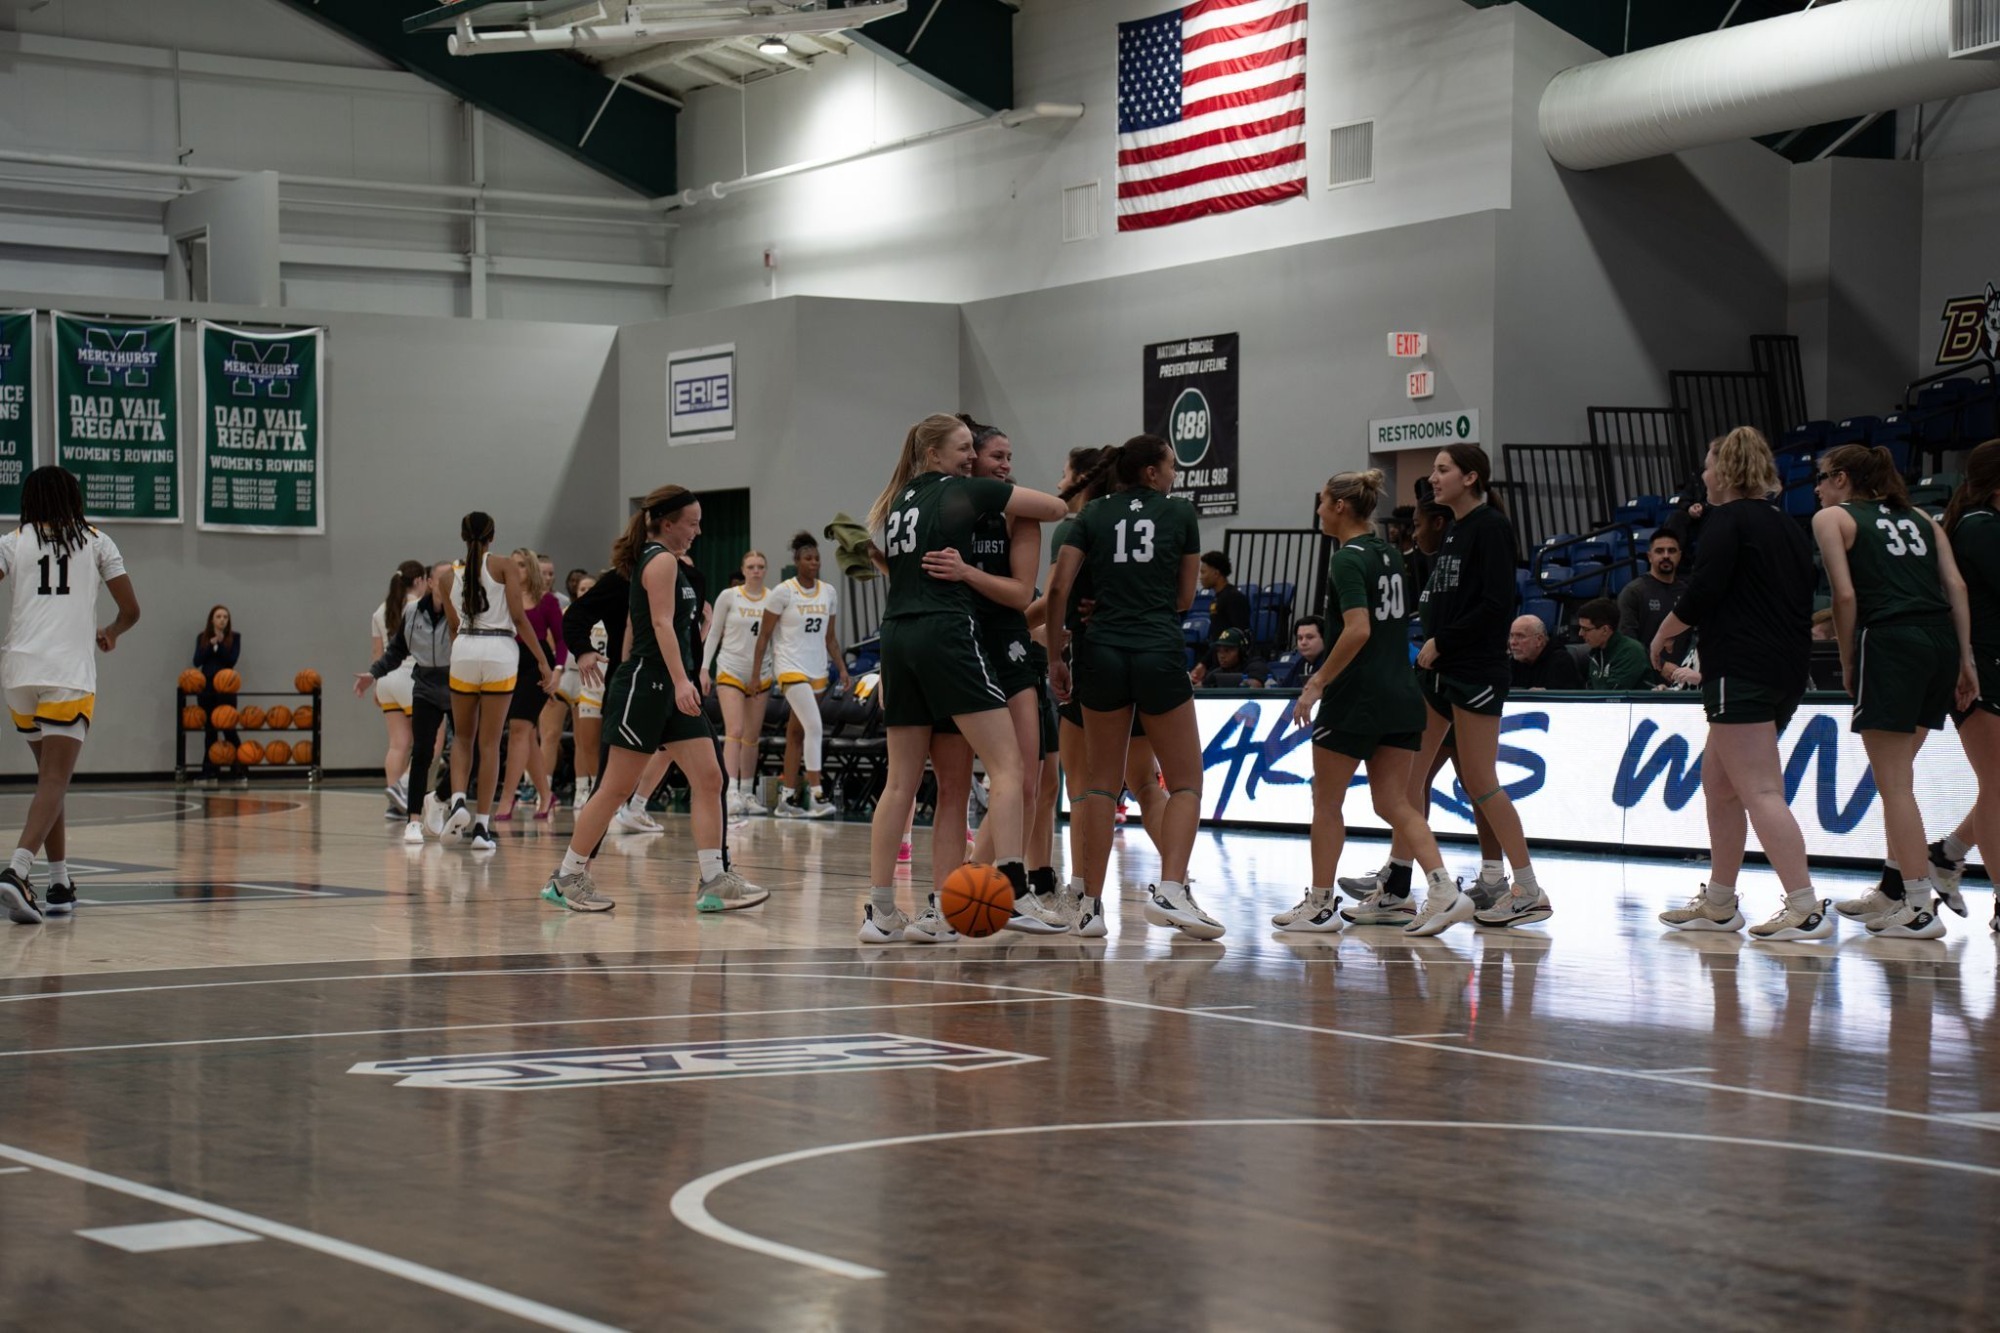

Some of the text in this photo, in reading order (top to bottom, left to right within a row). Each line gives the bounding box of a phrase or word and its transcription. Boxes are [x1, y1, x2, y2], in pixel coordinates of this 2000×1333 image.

[78, 348, 158, 364] MERCYHURST
[1396, 334, 1419, 355] EXIT
[224, 360, 299, 376] MERCYHURST
[1159, 357, 1228, 378] PREVENTION LIFELINE
[675, 375, 729, 415] ERIE
[1410, 373, 1427, 395] EXIT
[70, 394, 166, 420] DAD VAIL
[215, 405, 308, 431] DAD VAIL
[71, 417, 165, 441] REGATTA
[1176, 410, 1206, 440] 988
[1379, 420, 1453, 443] RESTROOMS
[217, 427, 307, 452] REGATTA
[63, 446, 174, 463] WOMEN'S ROWING
[210, 455, 314, 473] WOMEN'S ROWING
[1187, 470, 1209, 487] CALL
[1211, 468, 1228, 486] 988
[886, 507, 919, 557] 23
[1113, 519, 1155, 563] 13
[1876, 518, 1927, 556] 33
[37, 554, 70, 595] 11
[1375, 573, 1405, 621] 30
[750, 621, 759, 636] 4
[805, 618, 822, 633] 23
[1612, 714, 1880, 834] WN
